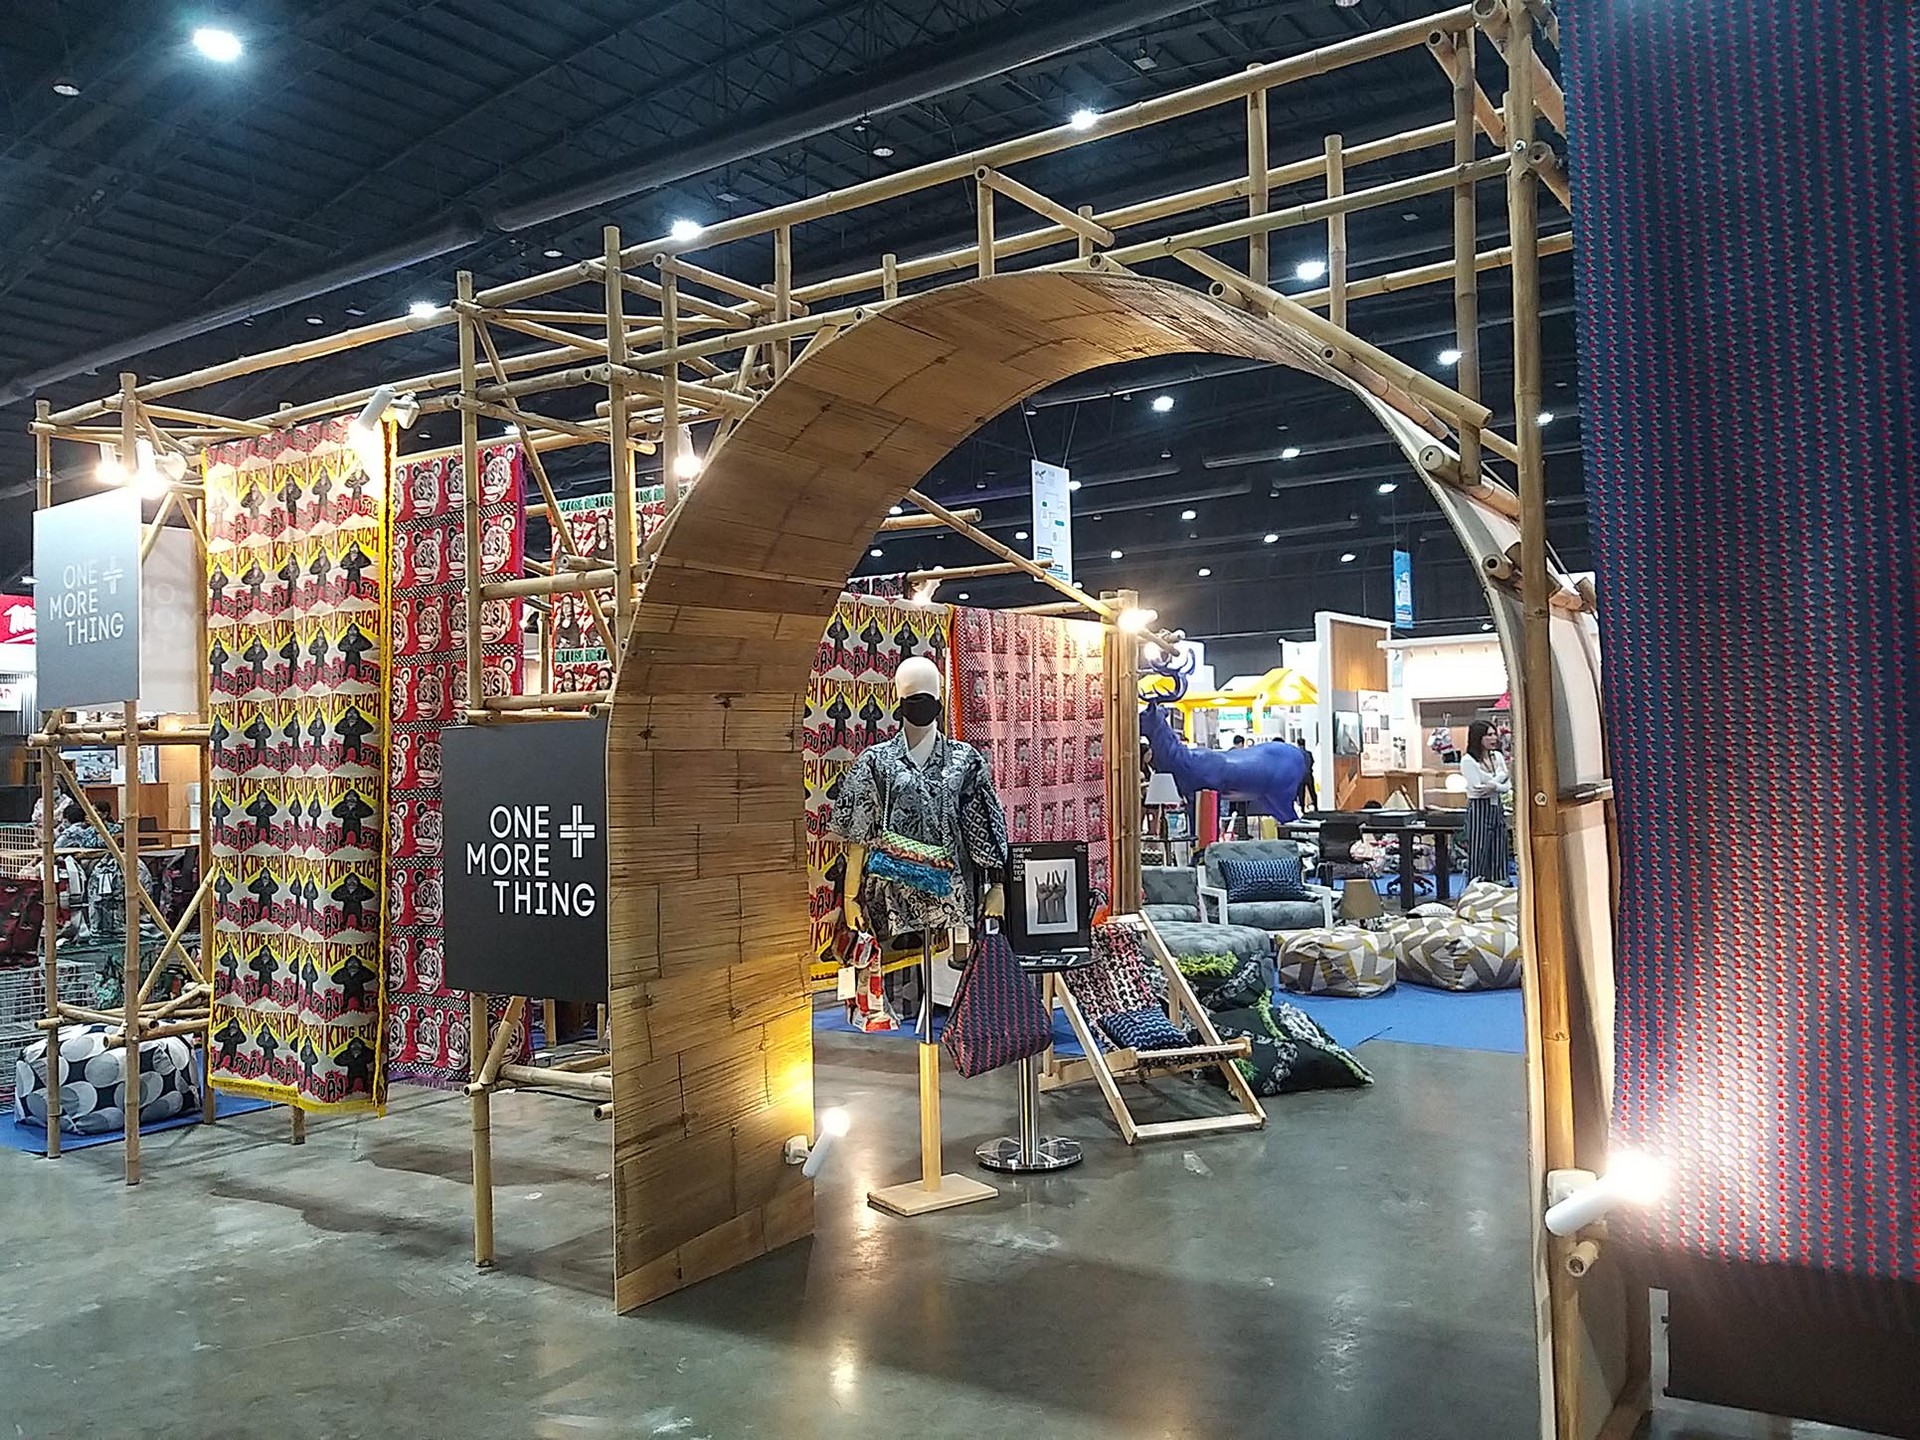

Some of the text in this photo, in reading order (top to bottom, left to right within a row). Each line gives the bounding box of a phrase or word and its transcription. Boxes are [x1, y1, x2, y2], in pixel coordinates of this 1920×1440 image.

[356, 527, 379, 552] RICH
[63, 561, 98, 589] ONE
[50, 588, 98, 621] MORE
[65, 612, 124, 646] THING
[355, 610, 380, 638] RICH
[330, 692, 380, 724] KING RICH
[819, 677, 840, 708] KING
[819, 758, 840, 790] KING
[238, 777, 261, 807] KING
[327, 776, 380, 806] KING RICH
[490, 805, 549, 839] ONE
[240, 855, 264, 884] KING
[466, 842, 549, 877] MORE
[818, 840, 841, 871] KING
[325, 858, 352, 890] KING
[355, 860, 380, 884] RICH
[493, 880, 595, 917] THING
[242, 931, 265, 960] KING
[325, 942, 352, 975] KING
[211, 1004, 236, 1028] KING
[325, 1024, 355, 1057] KING
